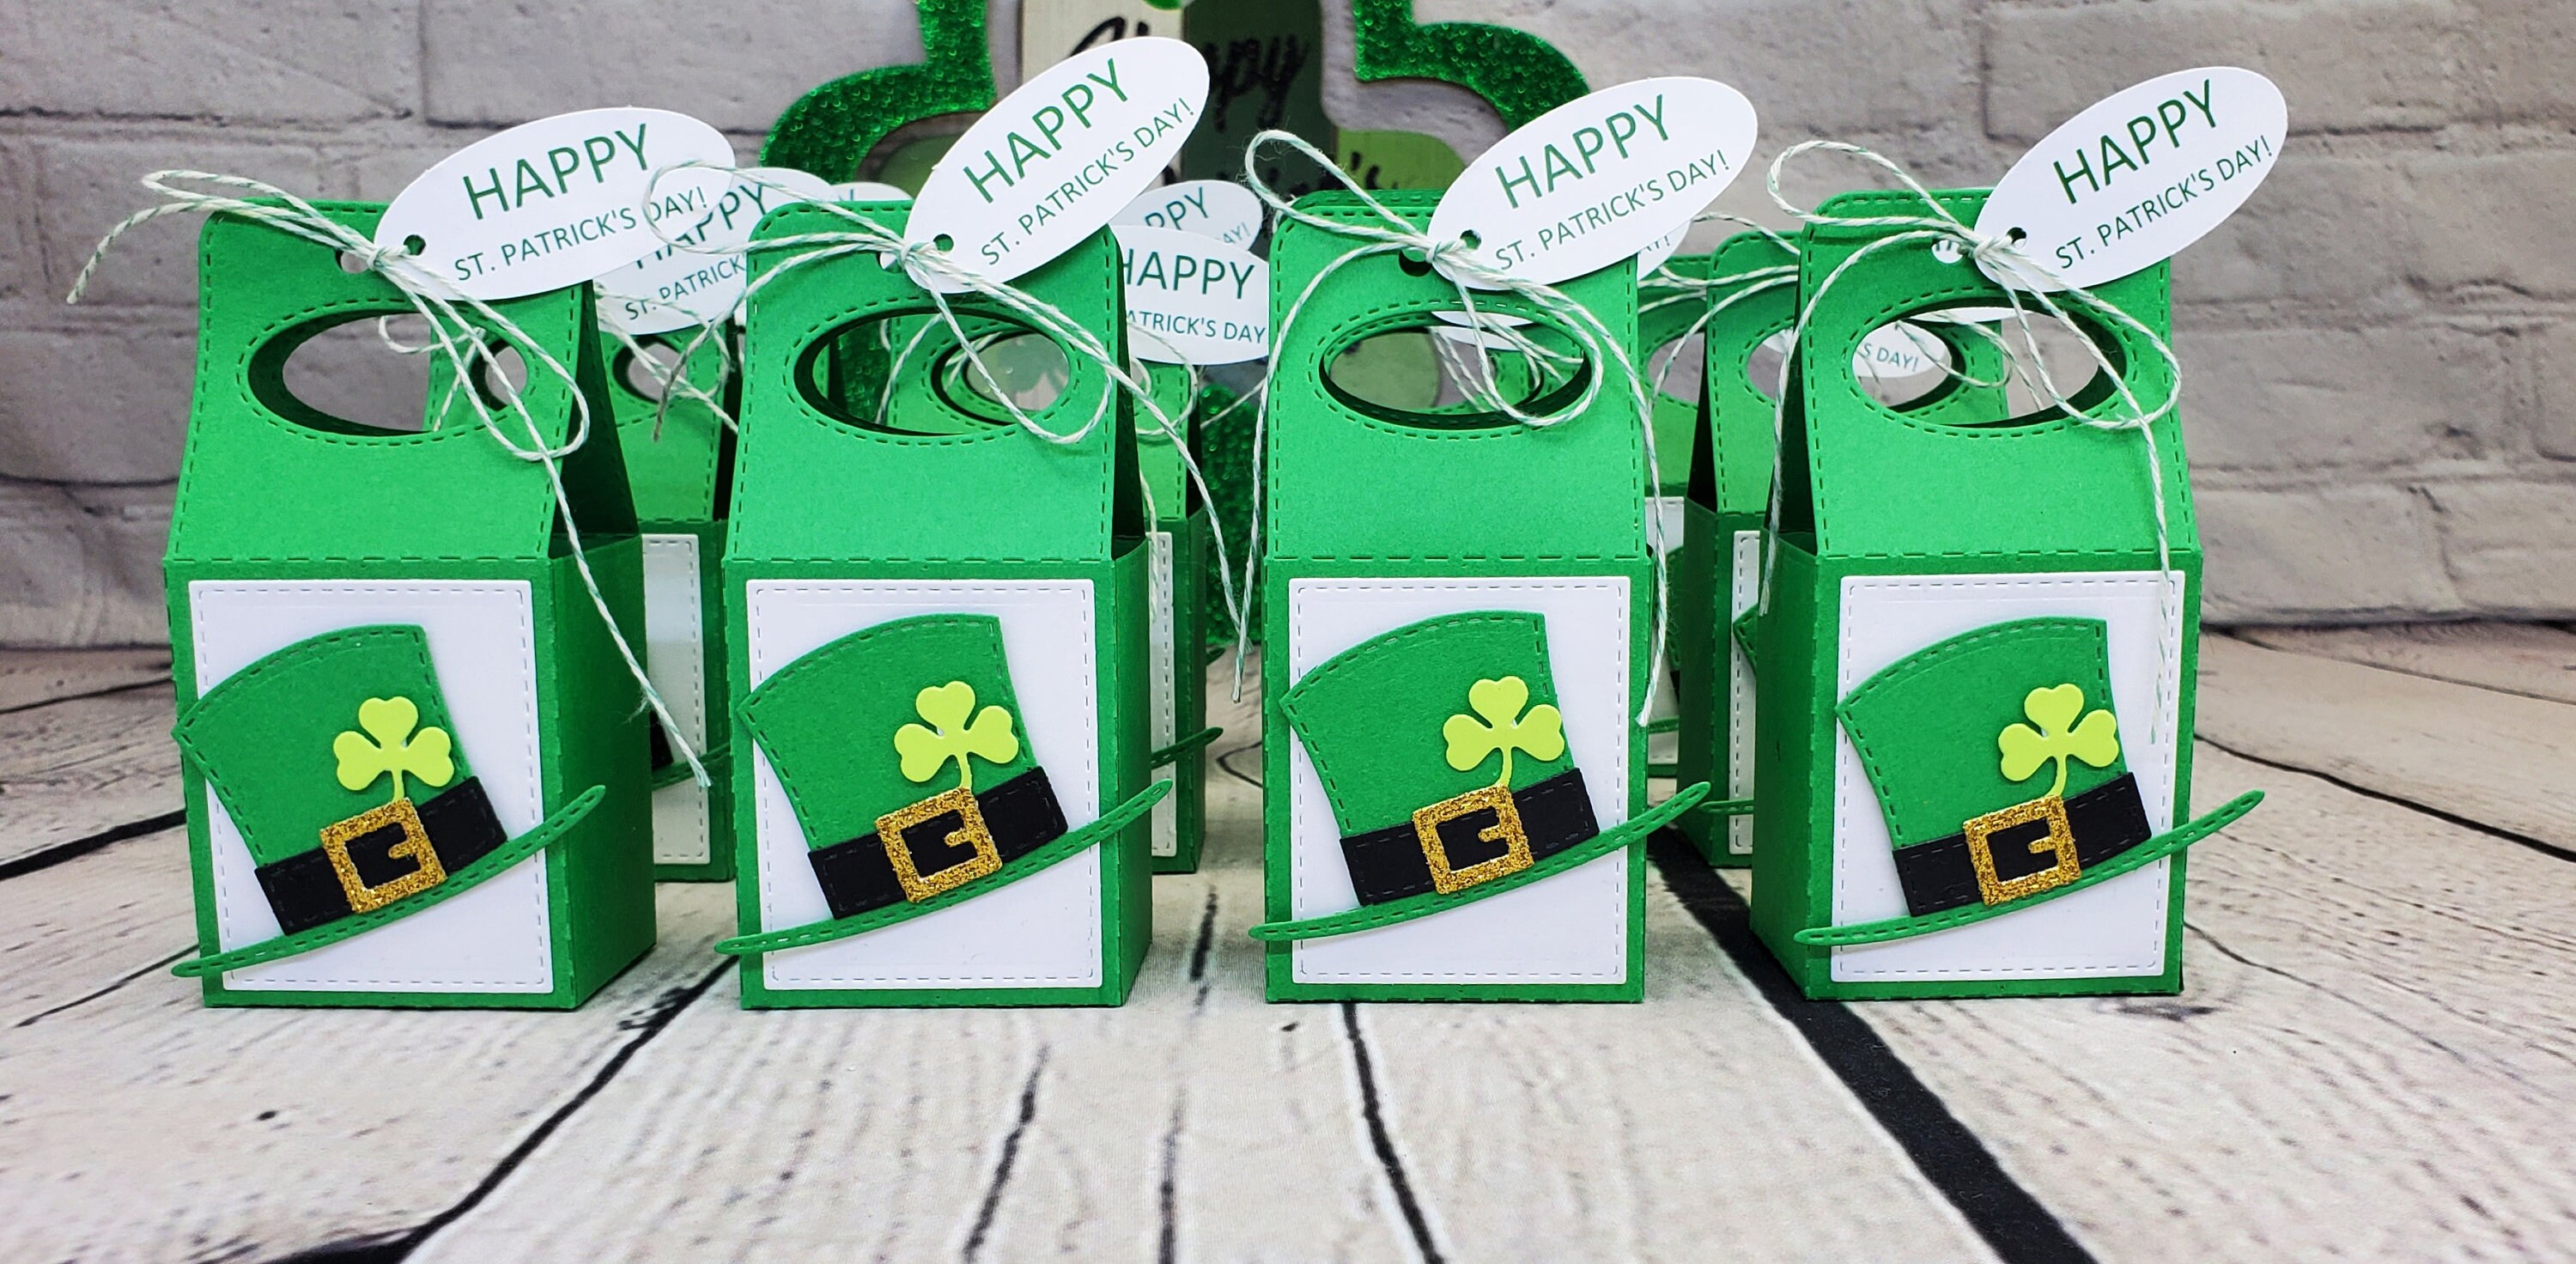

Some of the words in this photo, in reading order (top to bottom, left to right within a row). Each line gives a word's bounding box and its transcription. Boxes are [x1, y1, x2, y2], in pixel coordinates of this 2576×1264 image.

[463, 124, 647, 220] HAPPY
[963, 58, 1128, 203] HAPPY
[981, 232, 1021, 265] ST.
[1018, 141, 1135, 235] PATRICK'S
[1133, 98, 1194, 149] DAY!
[1495, 94, 1668, 209] HAPPY
[2053, 79, 2216, 204] HAPPY
[454, 253, 496, 281] ST.
[501, 208, 636, 265] PATRICK'S
[1495, 239, 1536, 270] ST.
[1538, 179, 1664, 251] PATRICK'S
[1667, 149, 1730, 192] DAY!
[2056, 237, 2095, 269] ST.
[2097, 168, 2215, 246] PATRICK'S
[2216, 135, 2273, 180] DAY!
[1127, 310, 1216, 337] ATRICK'S
[1224, 322, 1266, 343] DAY
